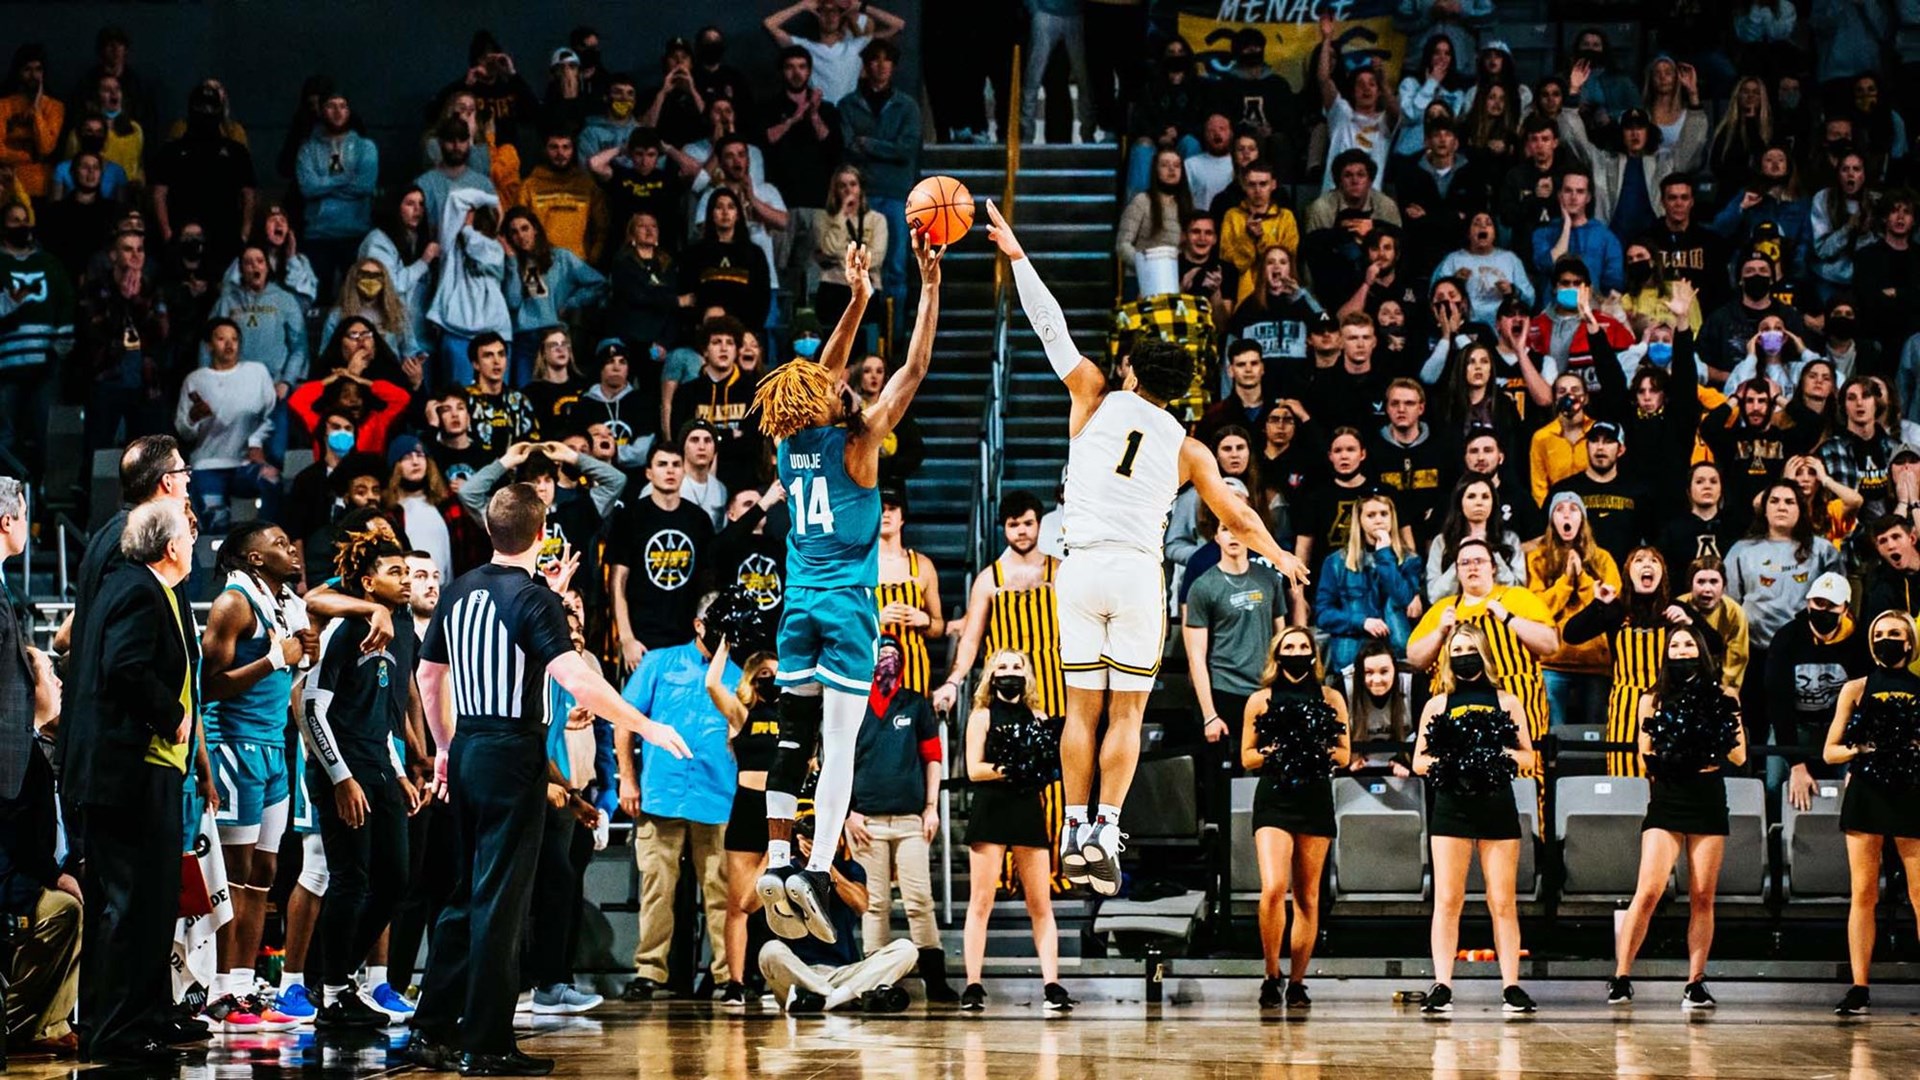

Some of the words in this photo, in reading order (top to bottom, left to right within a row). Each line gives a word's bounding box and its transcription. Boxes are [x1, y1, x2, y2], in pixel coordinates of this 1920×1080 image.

[1216, 0, 1356, 23] MENACE
[790, 453, 821, 470] UDUJE
[1116, 430, 1143, 478] 1
[789, 476, 835, 536] 14
[308, 716, 330, 752] CHANTS
[324, 745, 337, 763] UP
